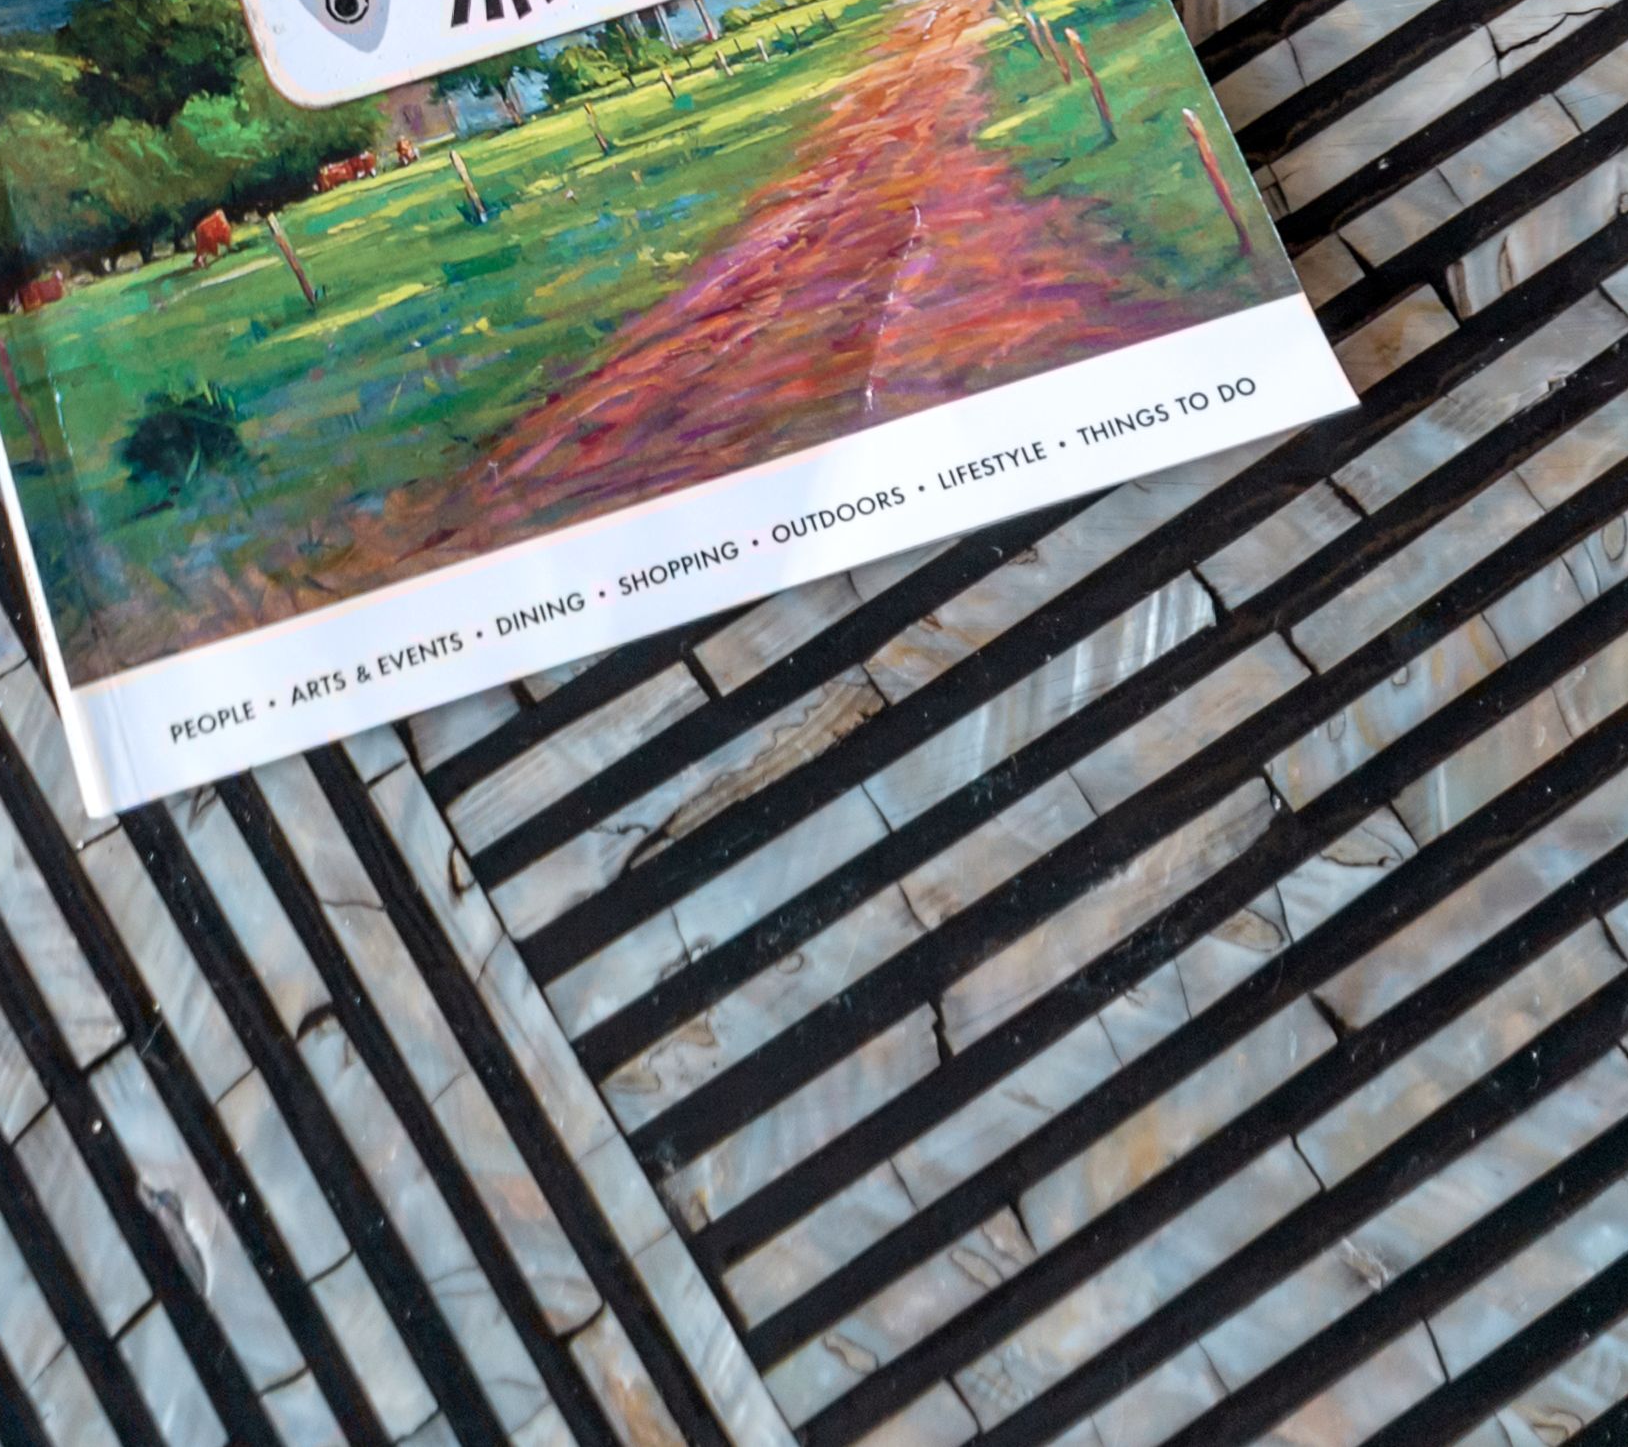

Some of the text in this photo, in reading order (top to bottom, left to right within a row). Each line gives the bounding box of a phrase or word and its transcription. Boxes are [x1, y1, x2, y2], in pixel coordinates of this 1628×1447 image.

[169, 701, 257, 743] PEOPLE
[290, 670, 348, 706] ARTS
[377, 632, 464, 676] EVENTS
[495, 592, 586, 636] DINING
[617, 541, 740, 597] SHOPPING
[770, 486, 906, 544] OUTDOORS
[936, 441, 1048, 490] LIFESTYLE
[1075, 404, 1171, 446] THINGS
[1175, 392, 1210, 415] TO
[1217, 377, 1257, 403] DO
